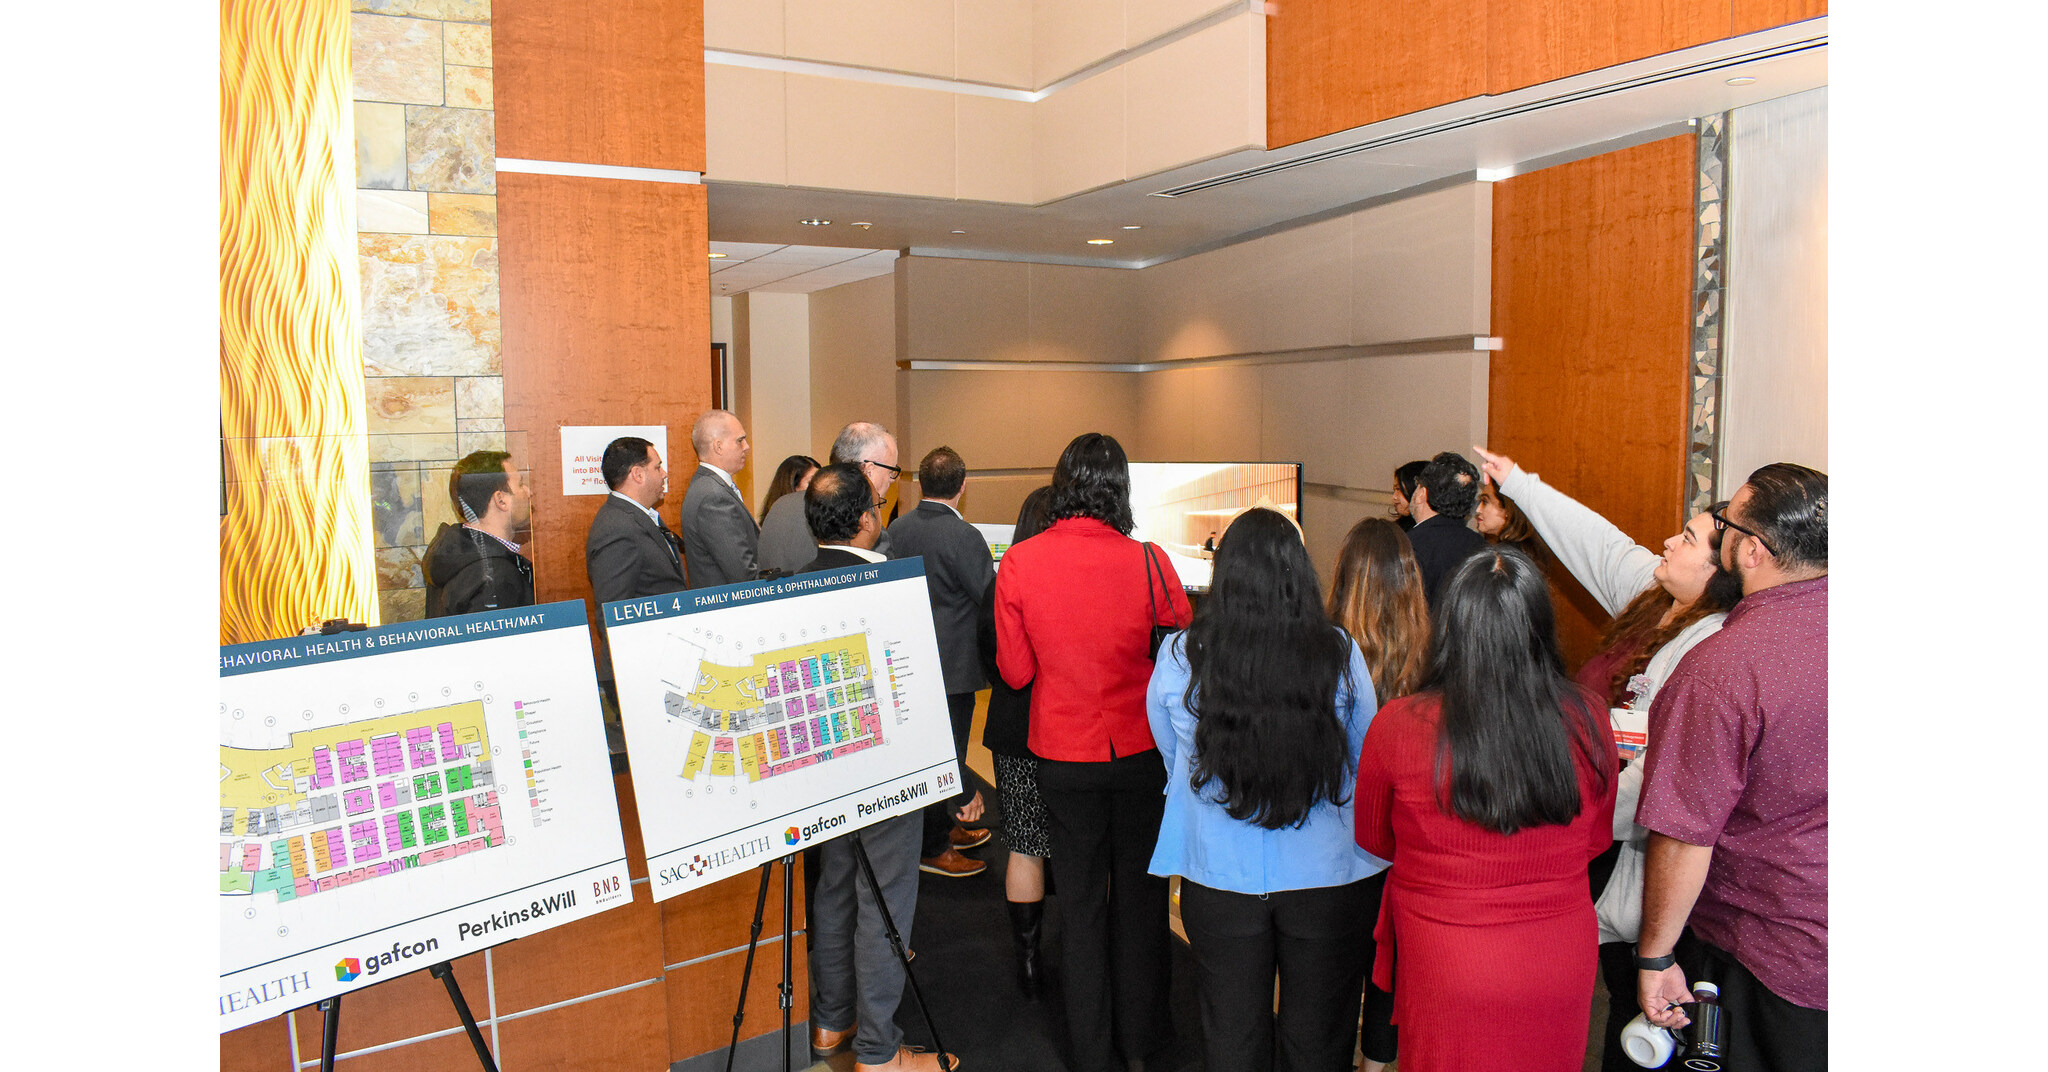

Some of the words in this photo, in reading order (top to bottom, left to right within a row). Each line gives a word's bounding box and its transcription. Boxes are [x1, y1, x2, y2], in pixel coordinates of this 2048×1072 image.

[694, 593, 729, 606] FAMILY
[731, 585, 775, 601] MEDICINE
[777, 584, 784, 594] &
[785, 573, 857, 593] OPHTHALMOLOGY
[864, 569, 879, 580] ENT
[613, 601, 663, 621] LEVEL
[672, 597, 681, 611] 4
[306, 639, 361, 657] HEALTH
[366, 637, 375, 648] &
[379, 626, 463, 647] BEHAVIORAL
[466, 614, 545, 635] HEALTH/MAT
[937, 772, 954, 788] BNB
[857, 781, 928, 818] Perkins&Will
[802, 814, 847, 841] gafcon
[659, 863, 690, 886] SAC
[707, 836, 771, 870] HEALTH
[593, 876, 620, 897] BNB
[458, 889, 577, 942] Perkins&Will
[365, 938, 439, 976] gafcon
